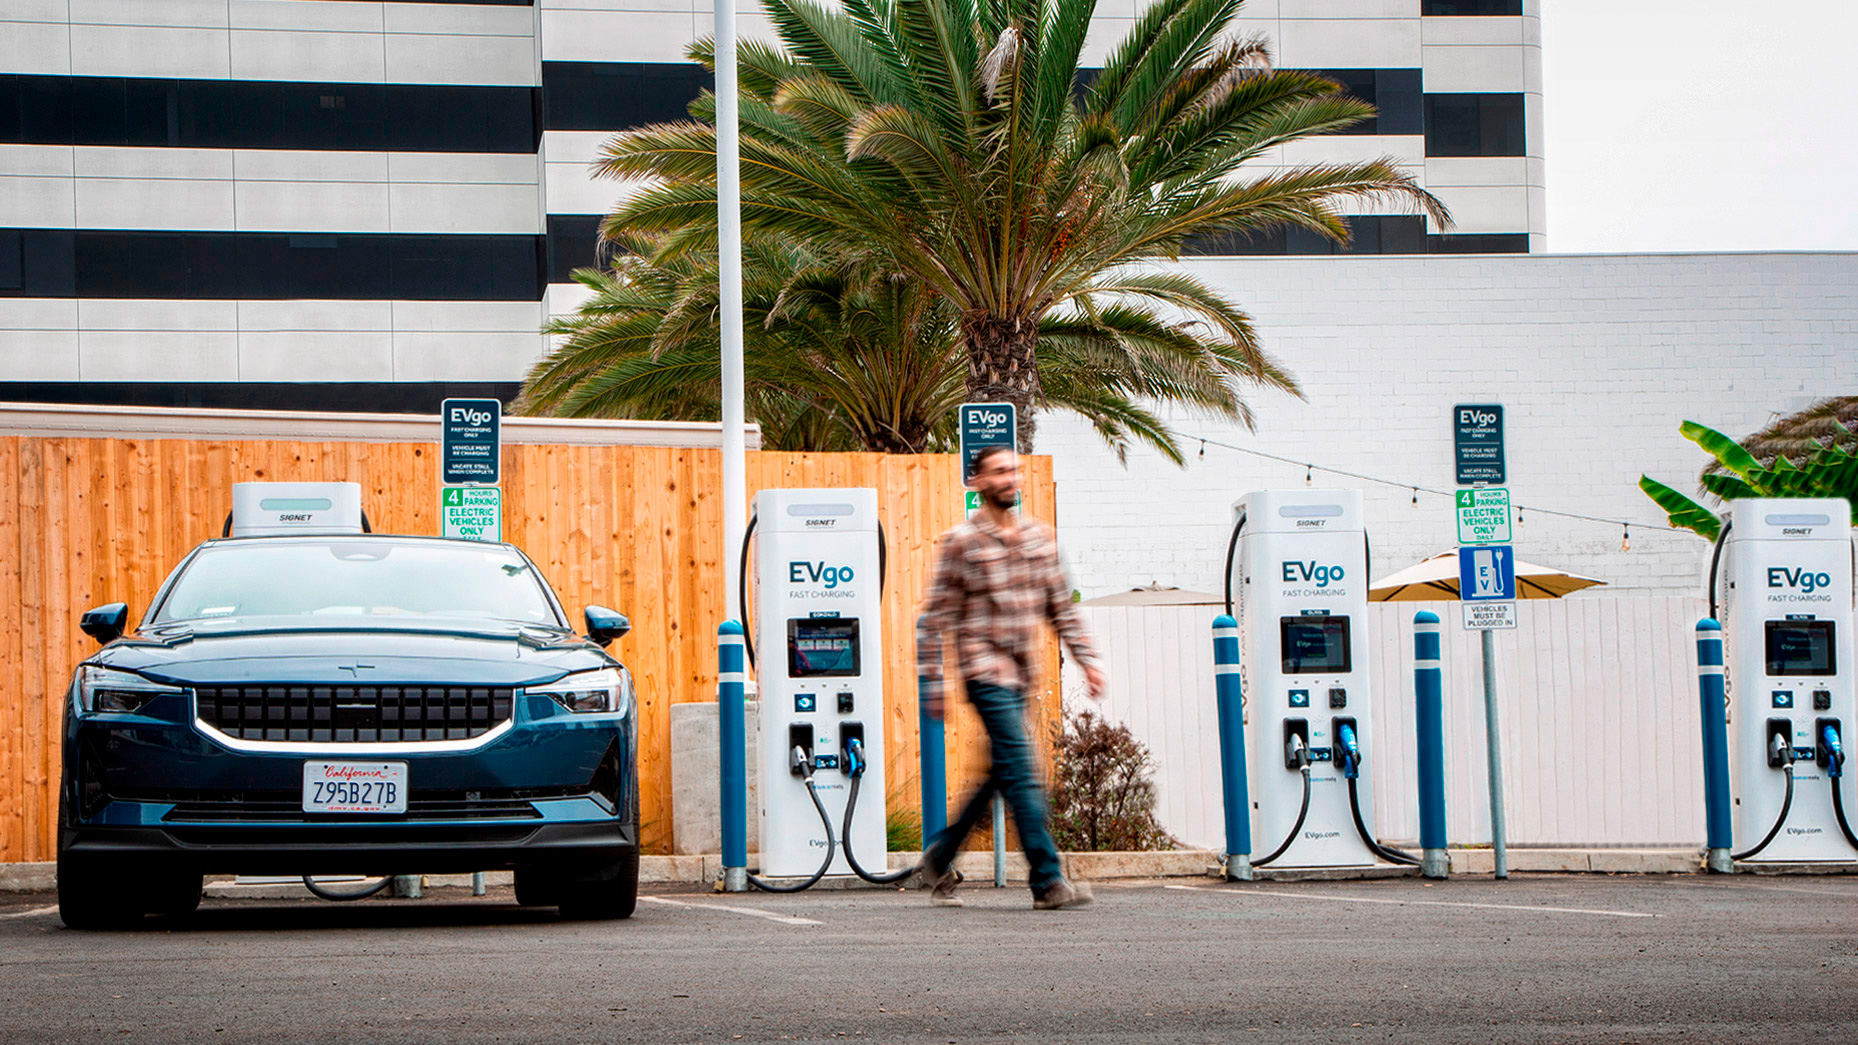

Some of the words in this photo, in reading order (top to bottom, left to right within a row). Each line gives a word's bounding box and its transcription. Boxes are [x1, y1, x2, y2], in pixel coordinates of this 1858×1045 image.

[451, 408, 492, 426] EVgo
[968, 410, 1007, 428] EVgo
[1460, 410, 1497, 428] EVgo
[448, 490, 459, 505] 4
[464, 497, 498, 506] PARKING
[971, 493, 981, 507] 4
[1461, 492, 1471, 505] 4
[1476, 498, 1507, 506] PARKING
[449, 508, 494, 516] ELECTRIC
[1463, 508, 1504, 517] ELECTRIC
[449, 517, 494, 526] VEHICLES
[1463, 517, 1505, 526] VEHICLES
[459, 526, 484, 535] ONLY
[1473, 526, 1496, 534] ONLY
[789, 561, 854, 589] EVgo
[1282, 560, 1345, 588] EVgo
[1767, 567, 1831, 593] EVgo
[789, 590, 810, 598] FAST
[811, 590, 855, 598] CHARGING
[1303, 589, 1346, 597] CHARGING
[325, 766, 388, 780] California
[313, 782, 397, 804] Z95B27B
[1787, 827, 1822, 835] EVgo.com
[1305, 832, 1340, 840] EVgo.com
